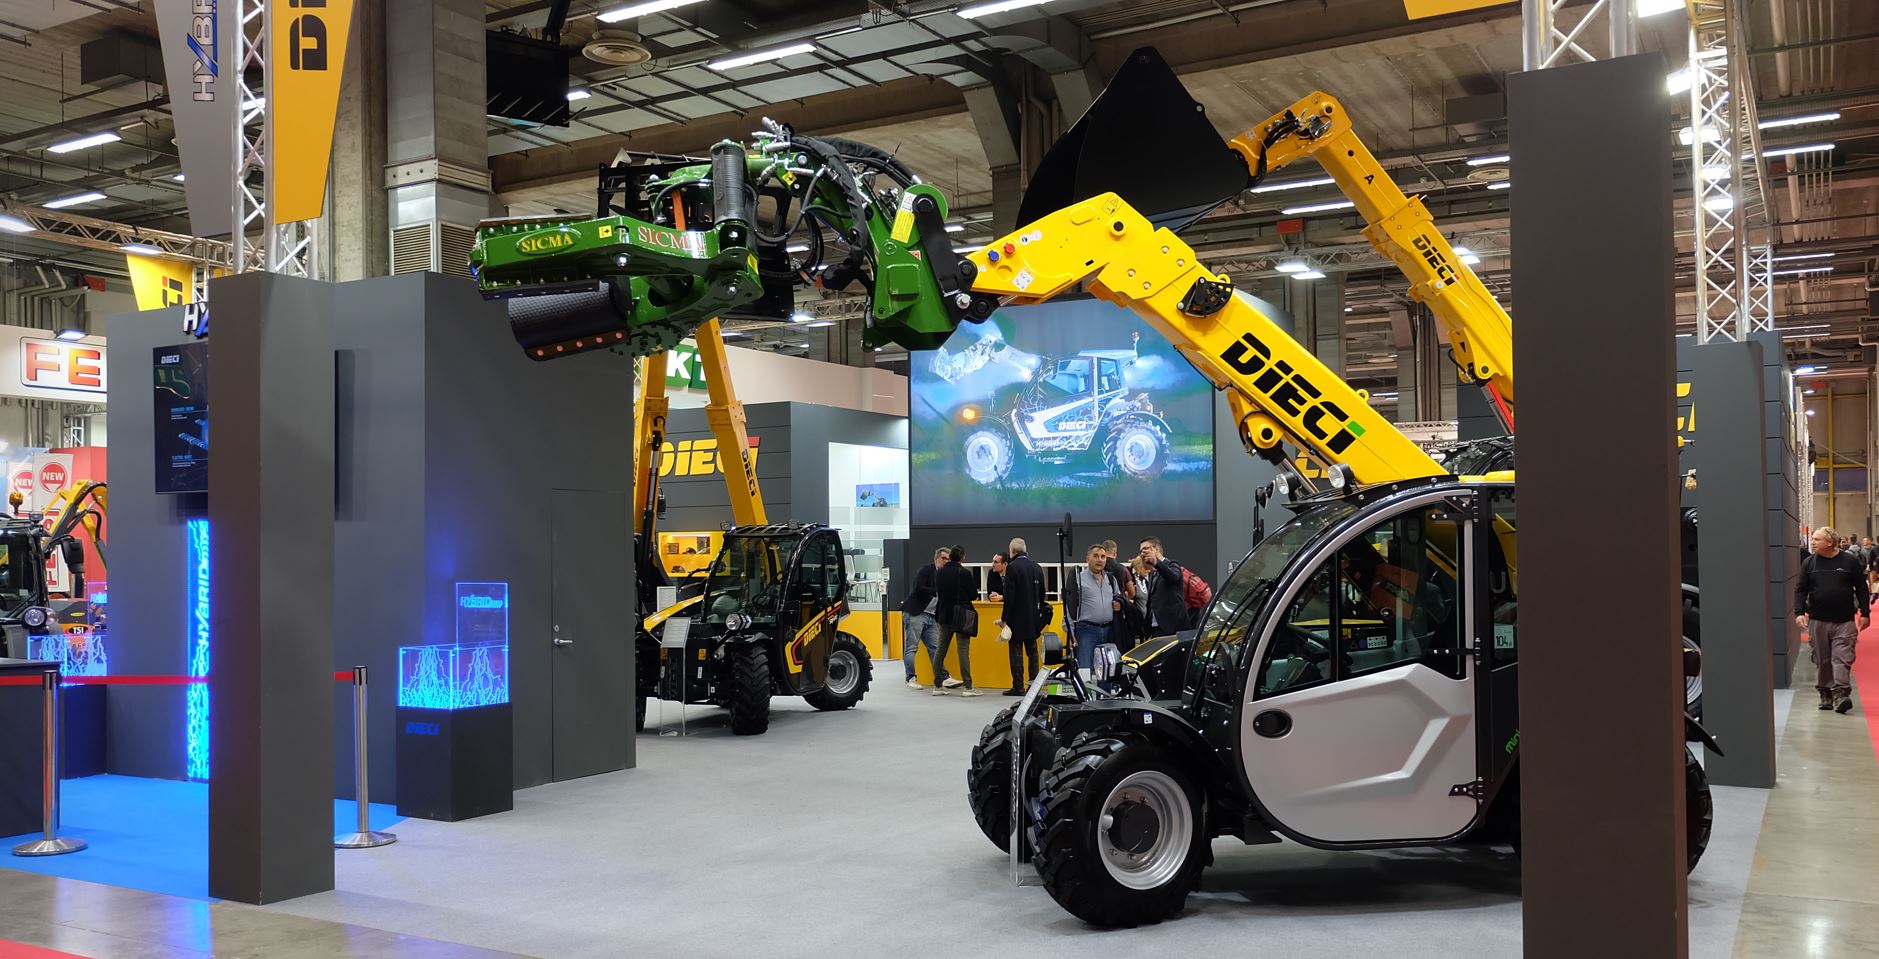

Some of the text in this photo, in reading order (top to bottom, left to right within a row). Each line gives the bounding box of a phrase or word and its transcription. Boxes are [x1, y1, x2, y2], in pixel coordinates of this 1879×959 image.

[1364, 174, 1375, 185] A
[521, 232, 575, 254] SICMA
[1411, 233, 1460, 287] DIECI
[26, 342, 101, 387] FE
[161, 354, 180, 364] DIECI
[1219, 332, 1366, 455] DIECI
[1057, 420, 1087, 431] DIECI
[659, 436, 761, 477] DIEI
[42, 472, 65, 481] NEW
[741, 449, 757, 497] DIECI
[1495, 635, 1509, 647] 104
